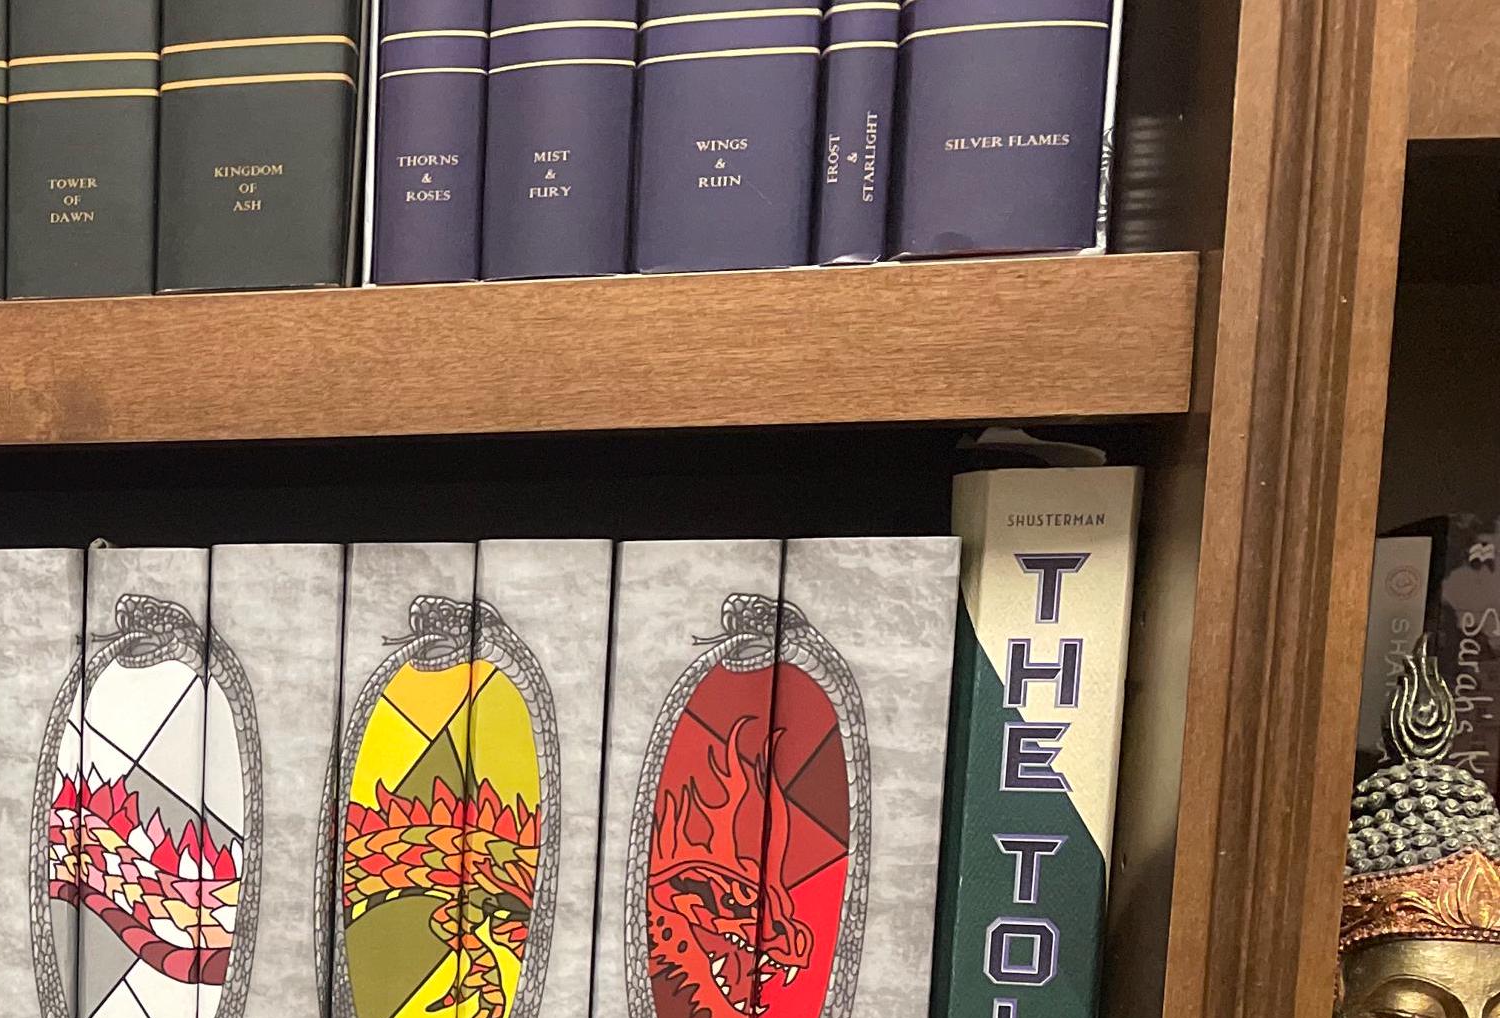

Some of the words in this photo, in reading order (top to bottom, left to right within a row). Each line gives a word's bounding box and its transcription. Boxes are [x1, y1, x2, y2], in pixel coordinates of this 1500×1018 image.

[696, 138, 749, 154] WINGS
[944, 136, 1005, 152] SILVER
[1008, 132, 1071, 148] FLAMES
[397, 153, 460, 168] THORNS
[533, 149, 572, 164] MIST
[826, 133, 841, 184] FROST
[846, 152, 858, 164] &
[862, 110, 878, 203] STARLIGHT
[213, 164, 284, 178] KINGDOM
[714, 158, 727, 171] &
[420, 172, 433, 184] &
[545, 168, 558, 180] &
[49, 177, 99, 190] TOWER
[698, 174, 742, 189] RUIN
[238, 183, 258, 195] OF
[405, 189, 452, 202] ROSES
[529, 184, 573, 199] FURY
[63, 195, 82, 206] OF
[232, 200, 262, 212] ASH
[49, 211, 95, 224] DAWN
[1007, 513, 1106, 527] SHUSTERMAN
[999, 552, 1092, 792] THE
